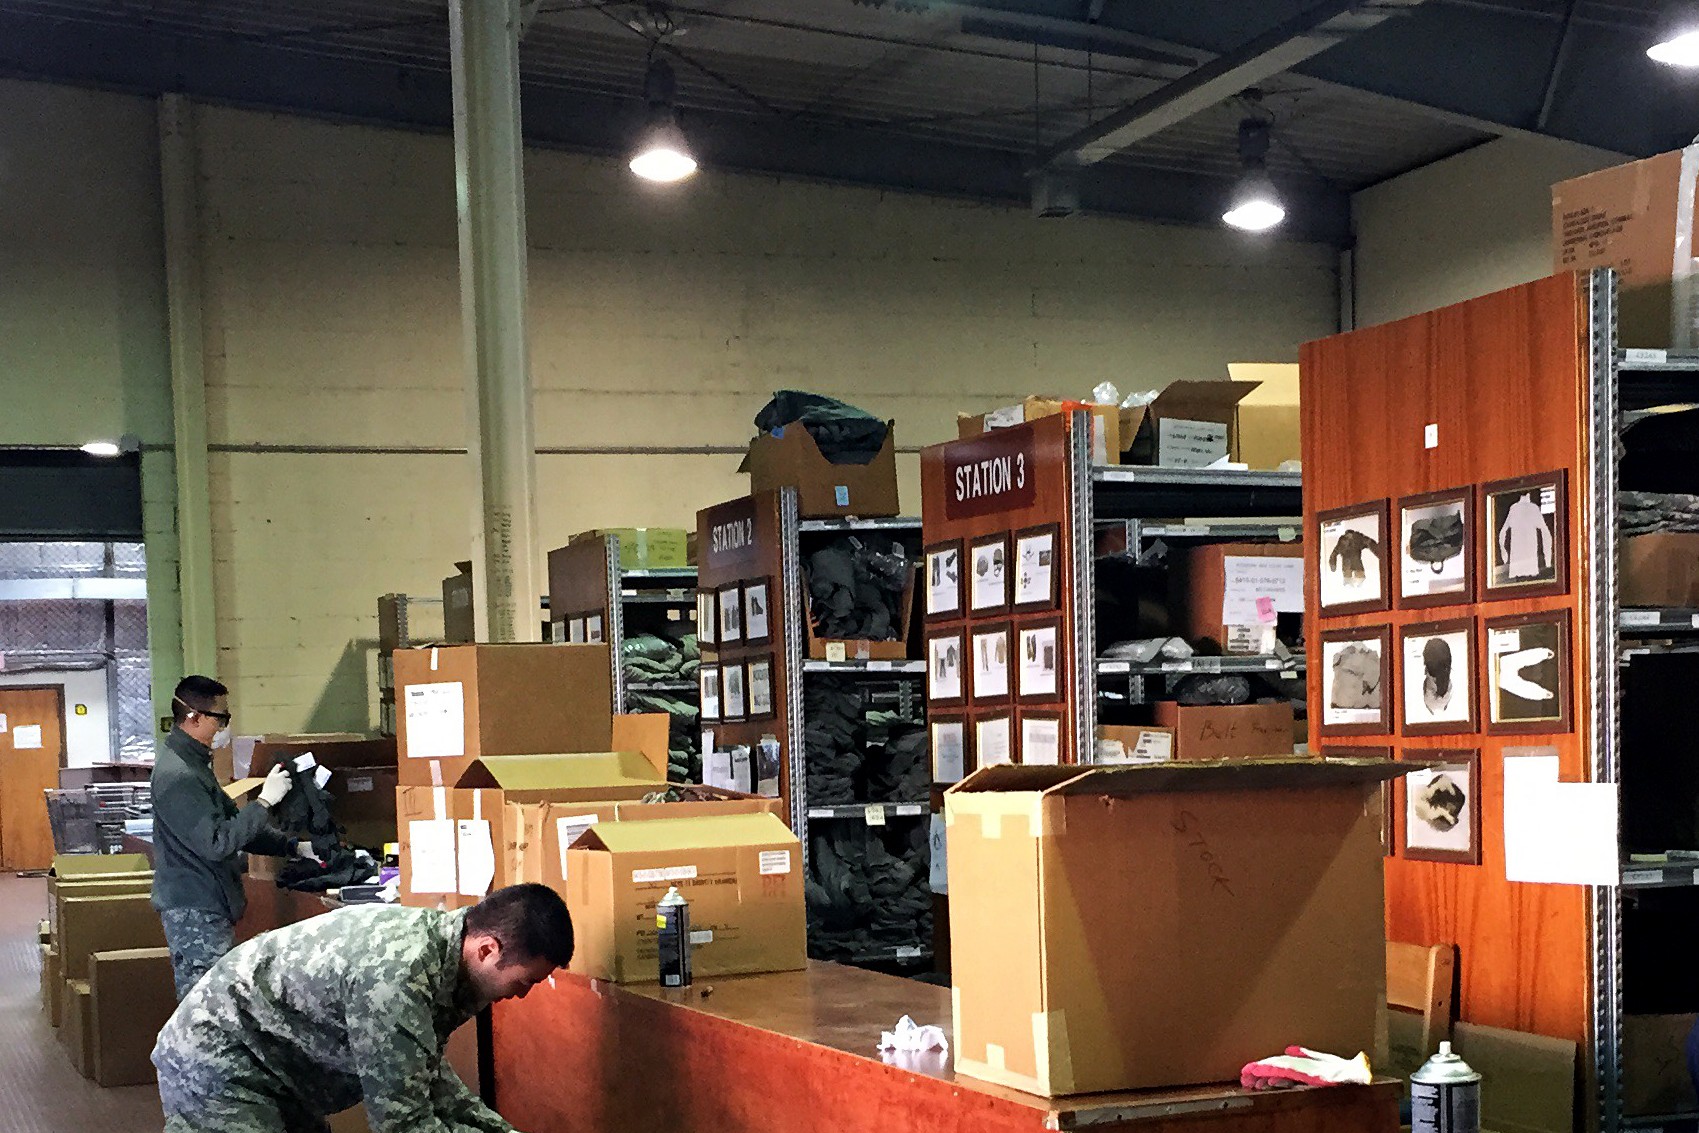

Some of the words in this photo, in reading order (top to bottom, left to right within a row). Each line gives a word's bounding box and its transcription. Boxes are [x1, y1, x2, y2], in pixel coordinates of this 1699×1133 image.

[955, 455, 1012, 502] STATION
[1016, 452, 1025, 489] 3
[712, 520, 745, 553] STATION
[746, 518, 753, 545] 2
[1171, 810, 1235, 897] STOCK
